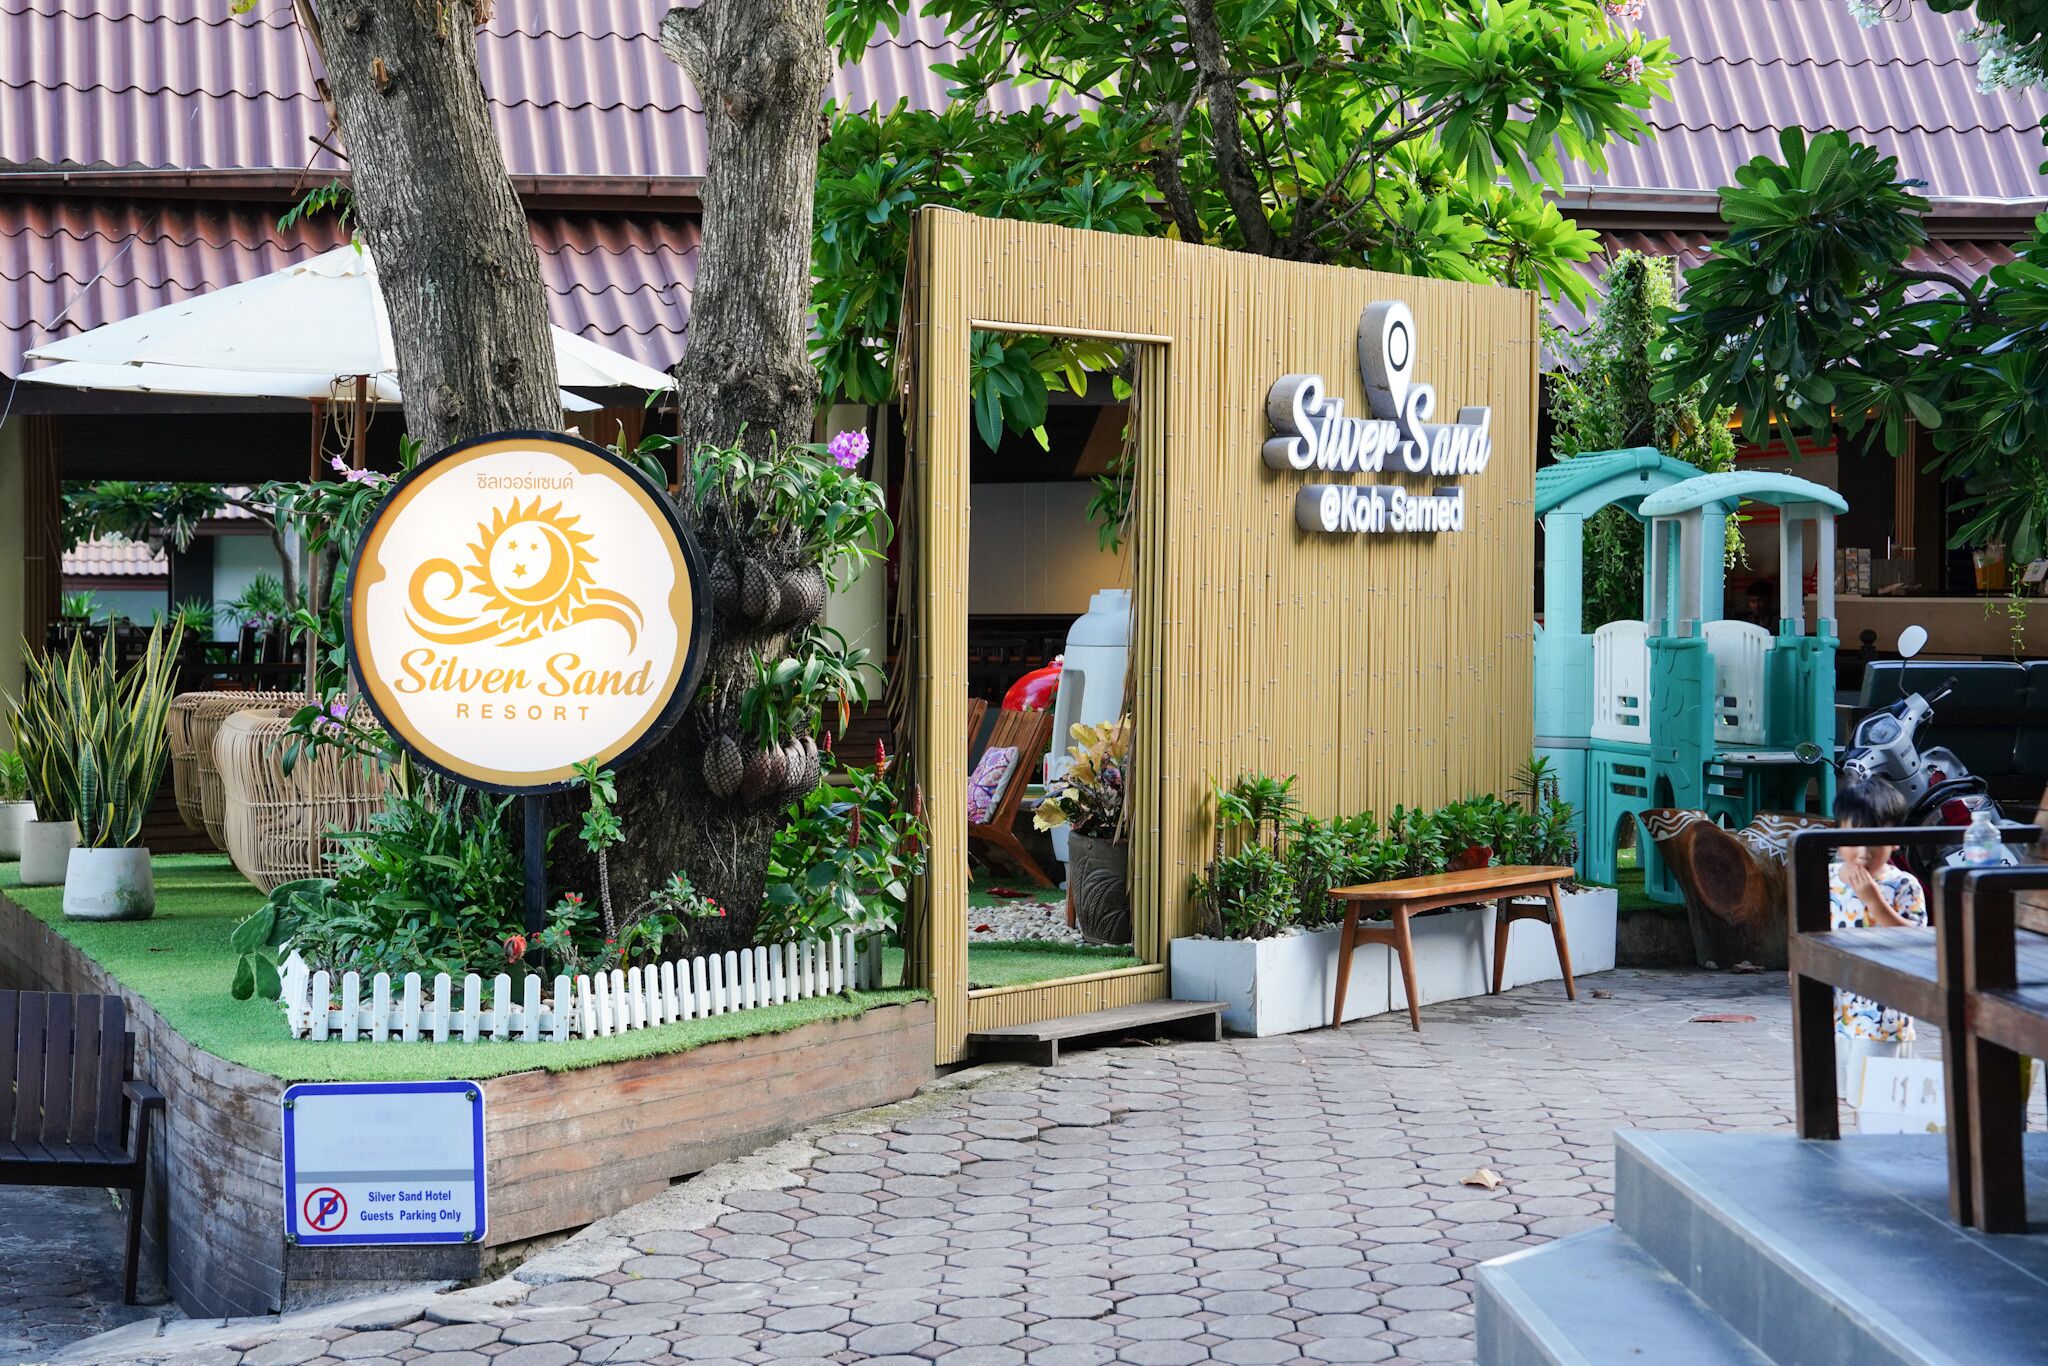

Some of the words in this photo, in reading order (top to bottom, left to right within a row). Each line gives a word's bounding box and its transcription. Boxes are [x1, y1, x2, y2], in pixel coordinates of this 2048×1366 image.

[1287, 374, 1400, 473] Silver
[1403, 383, 1491, 476] Sand
[476, 472, 574, 490] ซิลเวอร์แซนด์
[1319, 483, 1386, 533] @Koh
[1390, 484, 1464, 533] Samed
[394, 648, 531, 695] Silver
[537, 653, 654, 697] Sand
[456, 702, 590, 721] RESORT
[368, 1191, 396, 1203] Silver
[398, 1190, 423, 1202] Sand
[425, 1189, 452, 1201] Hotel
[360, 1209, 394, 1222] Guests
[400, 1208, 437, 1223] Parking
[439, 1207, 462, 1223] Only
